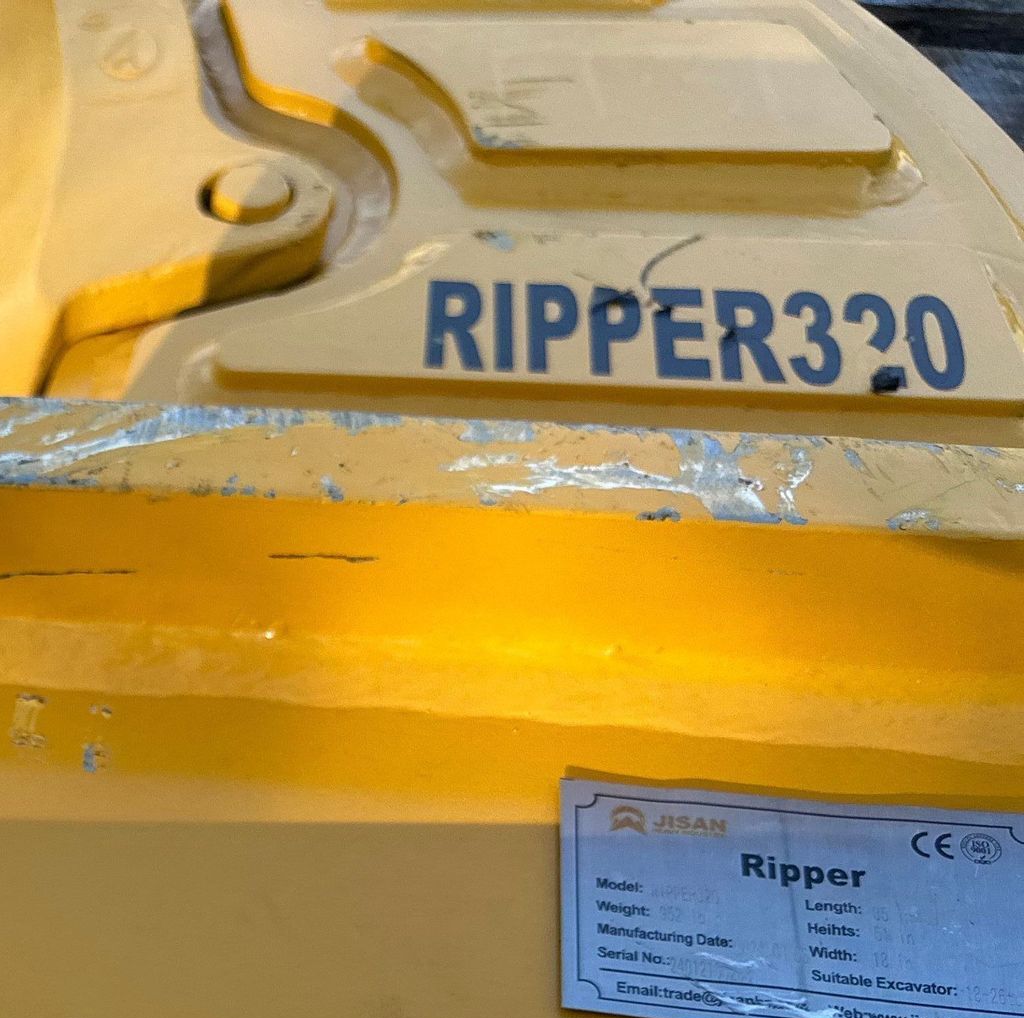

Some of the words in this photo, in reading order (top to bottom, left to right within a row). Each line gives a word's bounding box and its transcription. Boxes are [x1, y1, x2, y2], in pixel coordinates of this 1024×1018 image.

[423, 280, 967, 394] RIPPER320
[653, 815, 727, 833] JISAN
[741, 853, 865, 890] Ripper
[596, 878, 643, 893] Model:
[596, 901, 650, 917] Weight:
[805, 900, 862, 915] Length:
[597, 923, 693, 947] Manufacturing
[697, 933, 733, 948] Date:
[807, 922, 860, 937] Heihts:
[597, 947, 638, 962] Serial
[809, 946, 857, 962] Width:
[811, 970, 872, 988] Suitable
[876, 977, 958, 996] Excavator:
